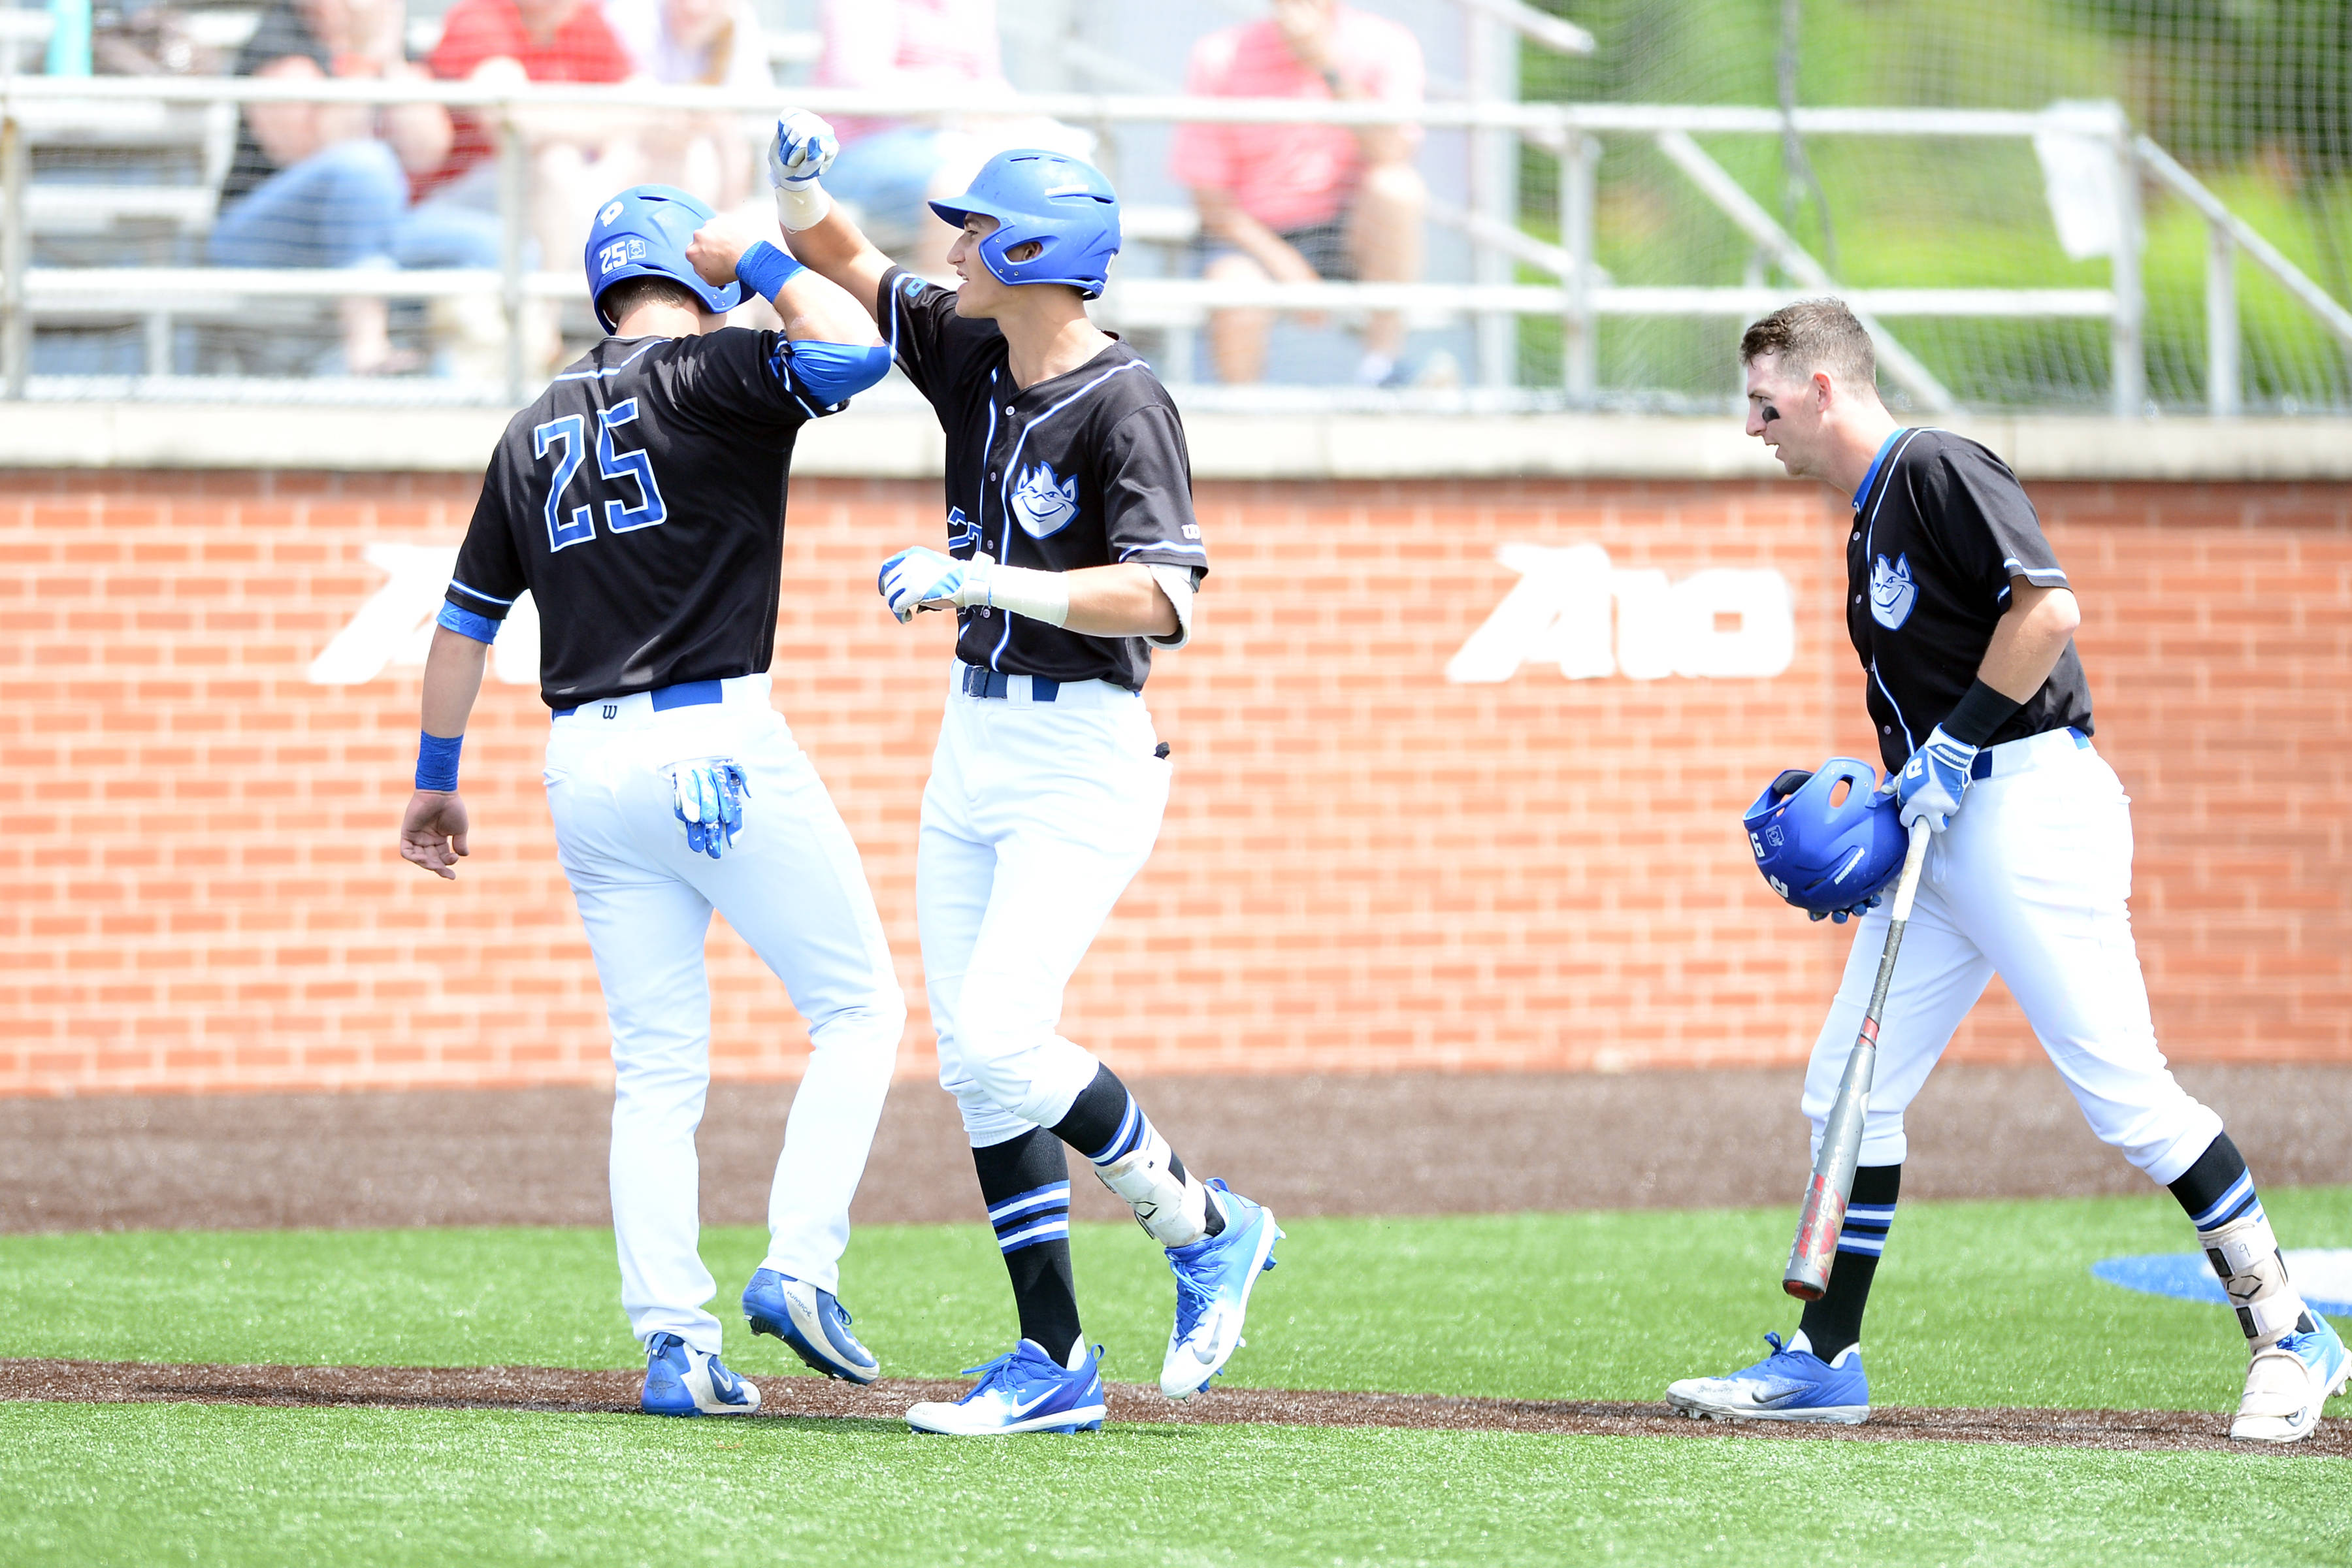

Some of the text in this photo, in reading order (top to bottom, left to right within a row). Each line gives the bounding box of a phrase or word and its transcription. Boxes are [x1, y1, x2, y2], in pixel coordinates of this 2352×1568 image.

[599, 240, 628, 275] 25
[534, 397, 668, 553] 25
[1445, 542, 1795, 683] A10
[2239, 1243, 2251, 1258] 9
